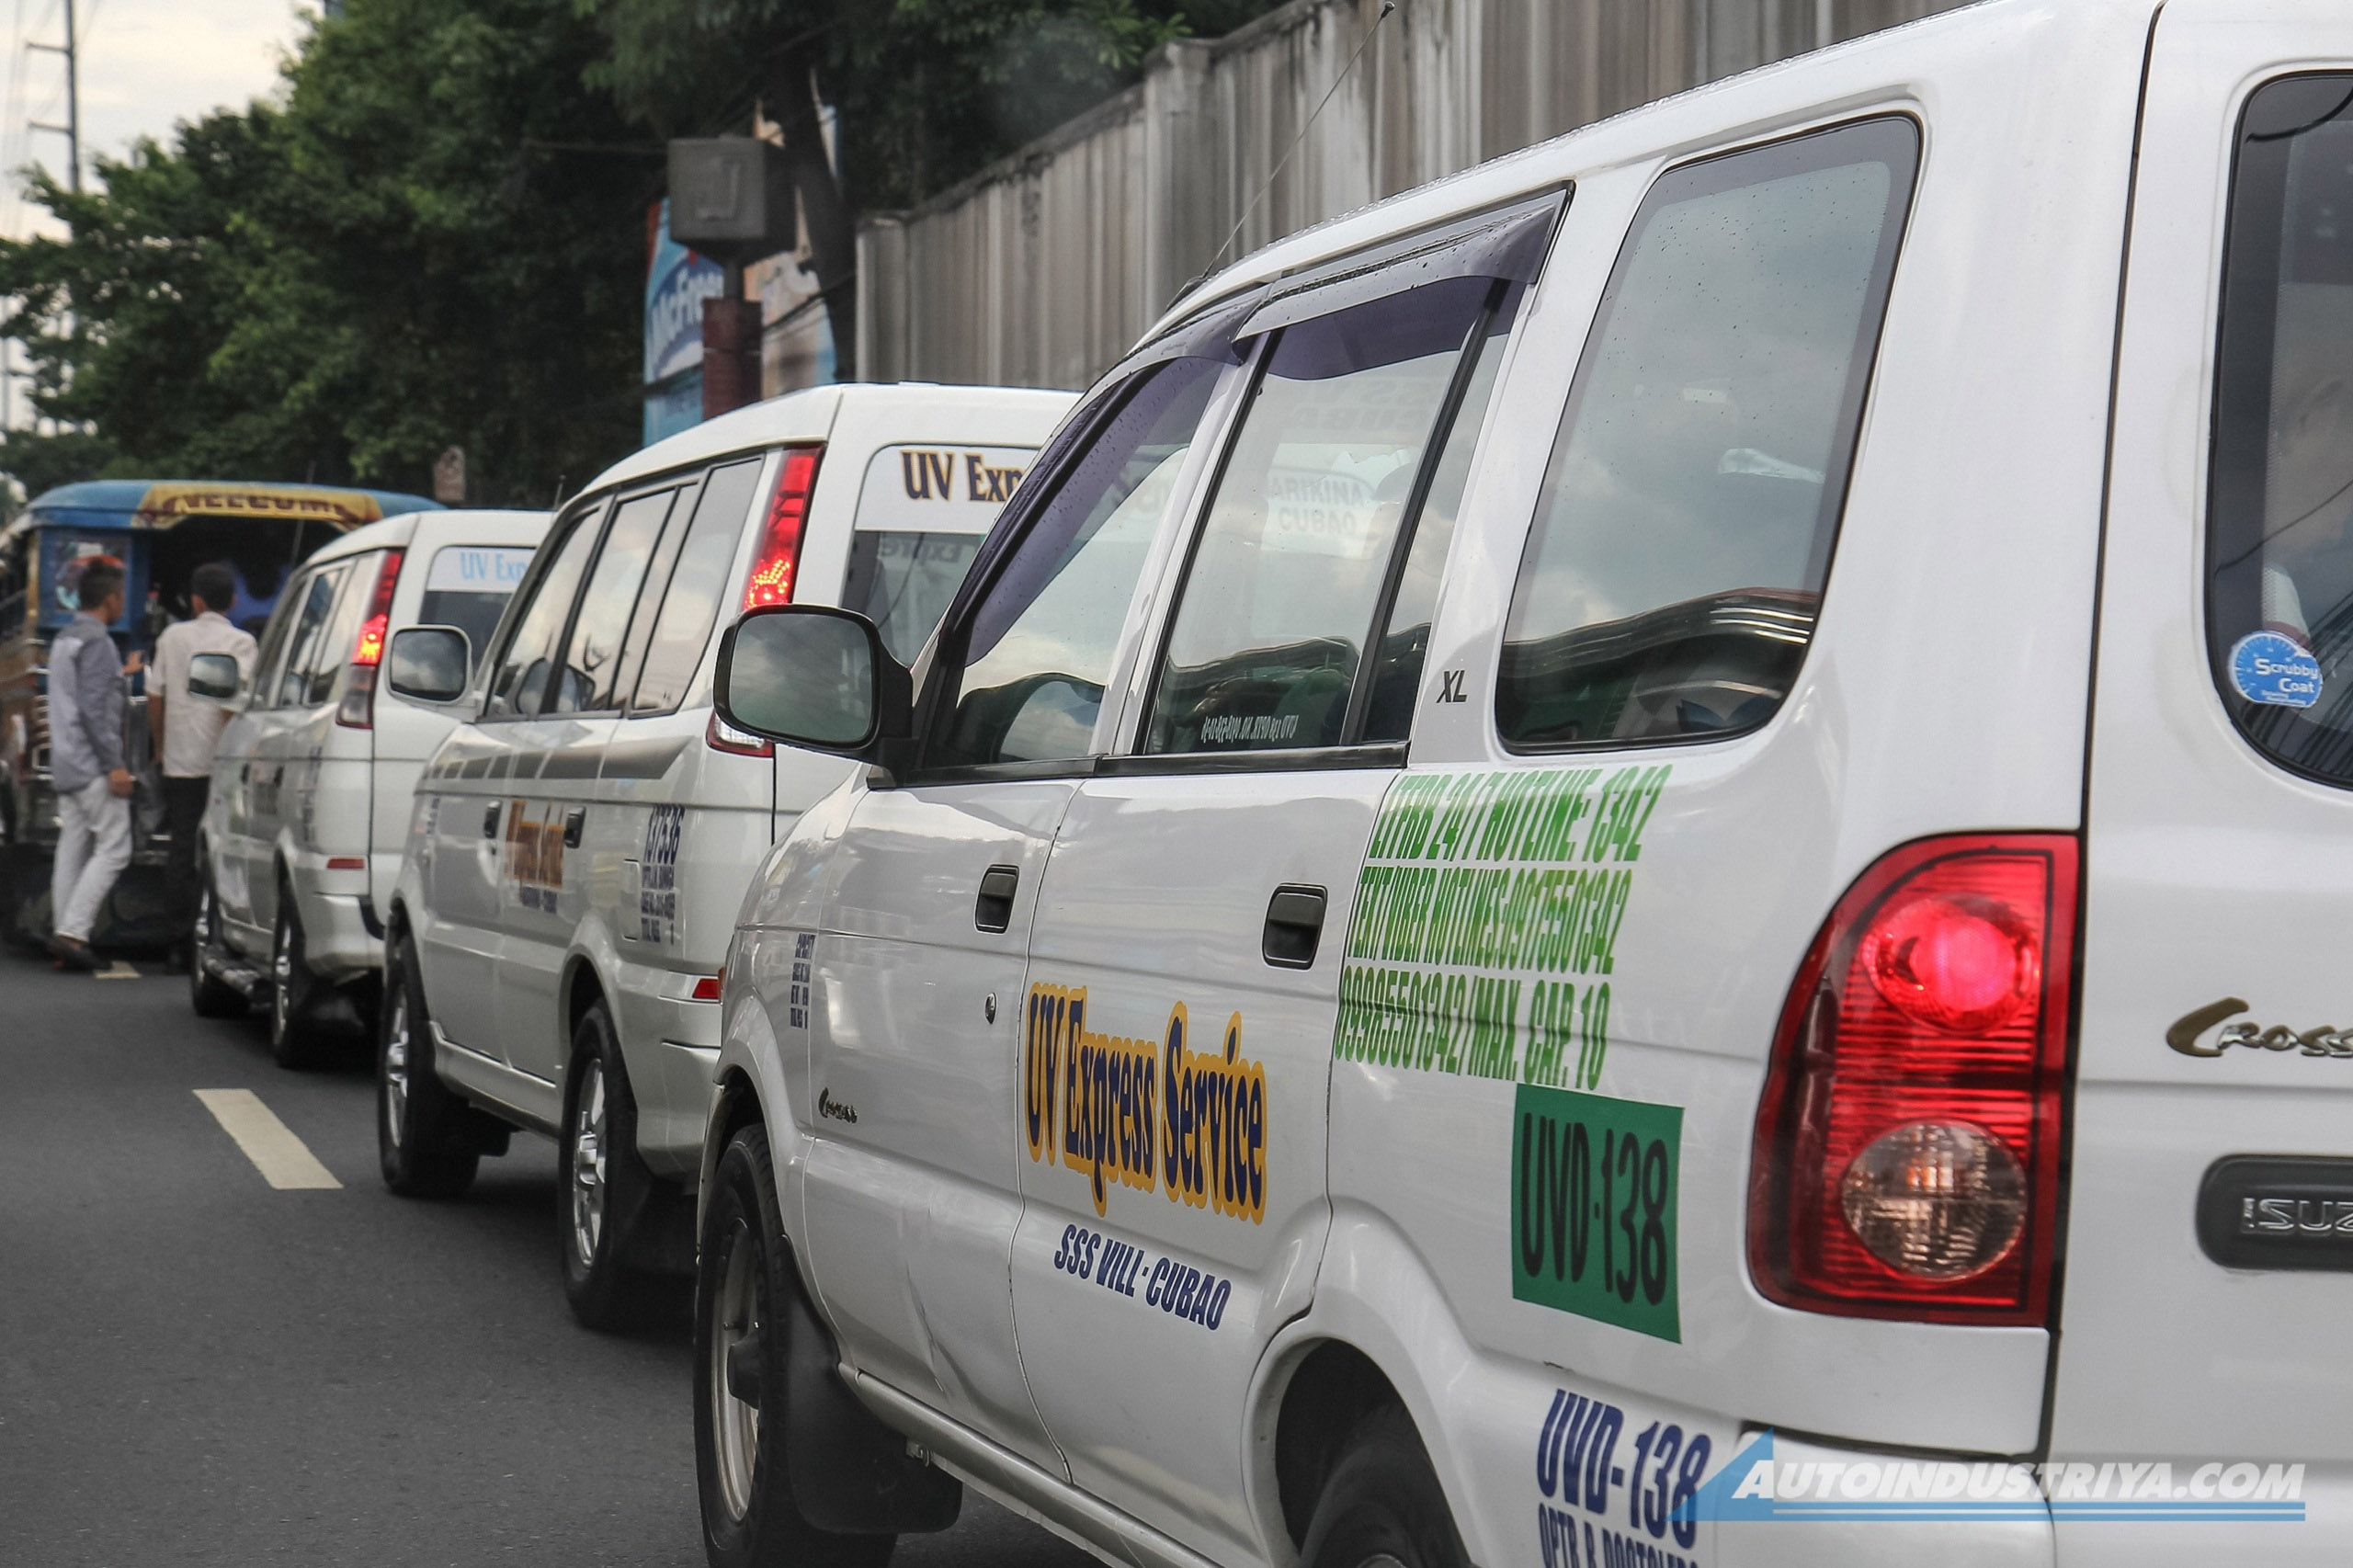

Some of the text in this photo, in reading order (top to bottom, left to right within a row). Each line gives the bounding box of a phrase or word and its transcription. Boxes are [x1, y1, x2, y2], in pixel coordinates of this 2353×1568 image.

[901, 450, 954, 501] UV
[460, 551, 488, 580] UV
[1437, 670, 1468, 703] XL
[2255, 658, 2318, 679] Scrubby
[2279, 678, 2314, 693] Coat
[1369, 774, 1453, 859] LTFRB
[1426, 772, 1507, 862] 24/7
[1581, 764, 1674, 863] 1342
[1575, 982, 1610, 1091] 10
[1026, 982, 1267, 1225] UV Express Service
[1054, 1223, 1101, 1279] SSS
[1145, 1256, 1232, 1332] CUBAO
[1537, 1388, 1711, 1551] UVD-138
